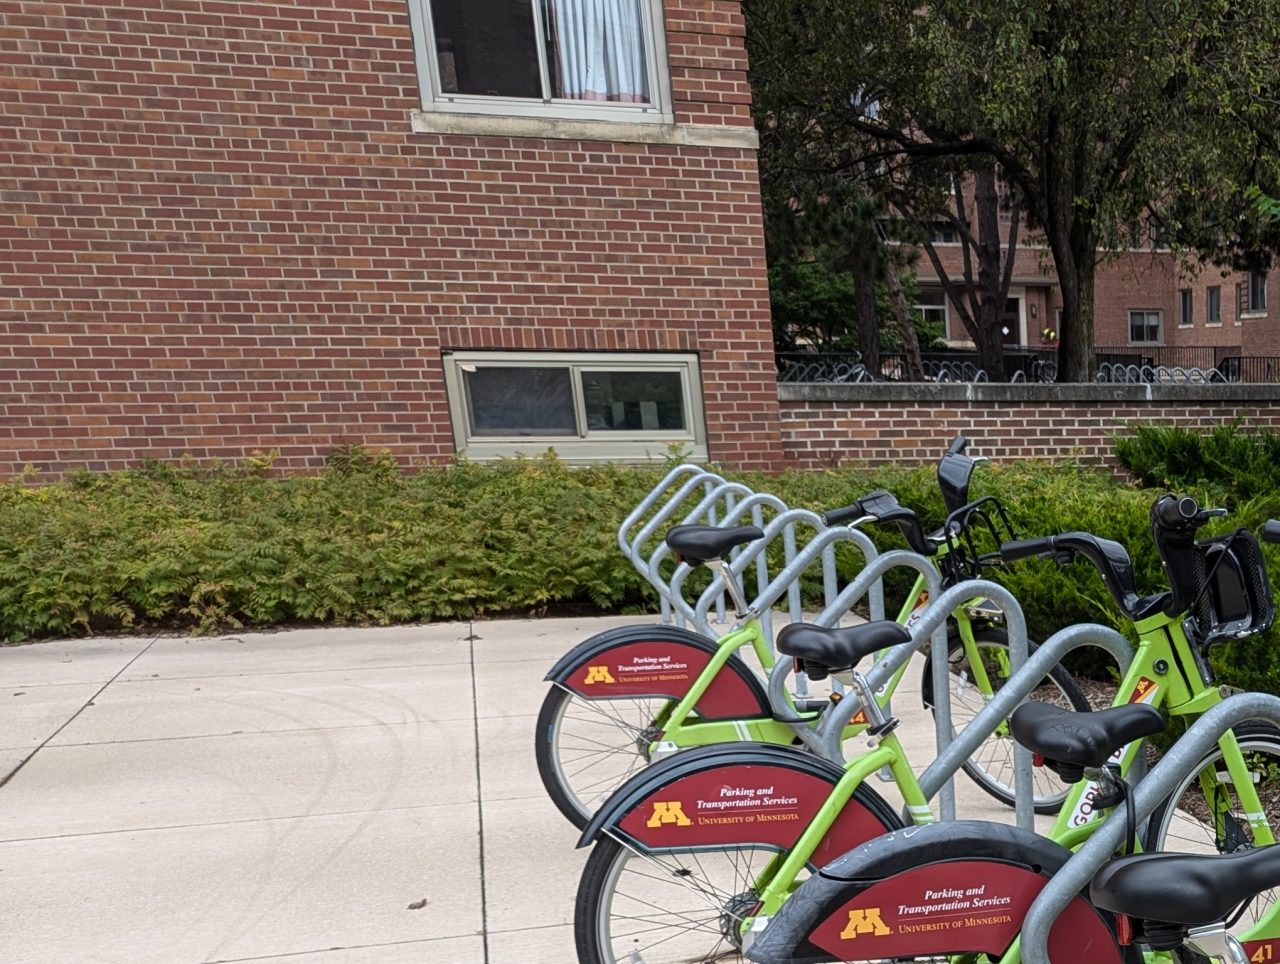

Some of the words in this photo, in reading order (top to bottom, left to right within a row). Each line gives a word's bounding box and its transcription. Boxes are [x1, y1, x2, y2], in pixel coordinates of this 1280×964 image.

[633, 656, 658, 664] Parking
[658, 655, 671, 663] and
[617, 664, 662, 672] Transportation
[663, 662, 688, 670] Services
[720, 787, 755, 797] Parking
[756, 786, 774, 796] and
[696, 797, 761, 810] Transportation
[762, 796, 798, 806] Services
[698, 816, 744, 826] UNIVERSITY
[757, 813, 800, 823] MINNESOTA
[924, 887, 964, 900] Parking
[965, 885, 985, 896] and
[897, 900, 970, 916] Transportation
[971, 895, 1012, 908] Services
[898, 921, 951, 934] UNIVERSITY
[964, 915, 1012, 927] MINNESOTA
[1250, 944, 1272, 964] 41
